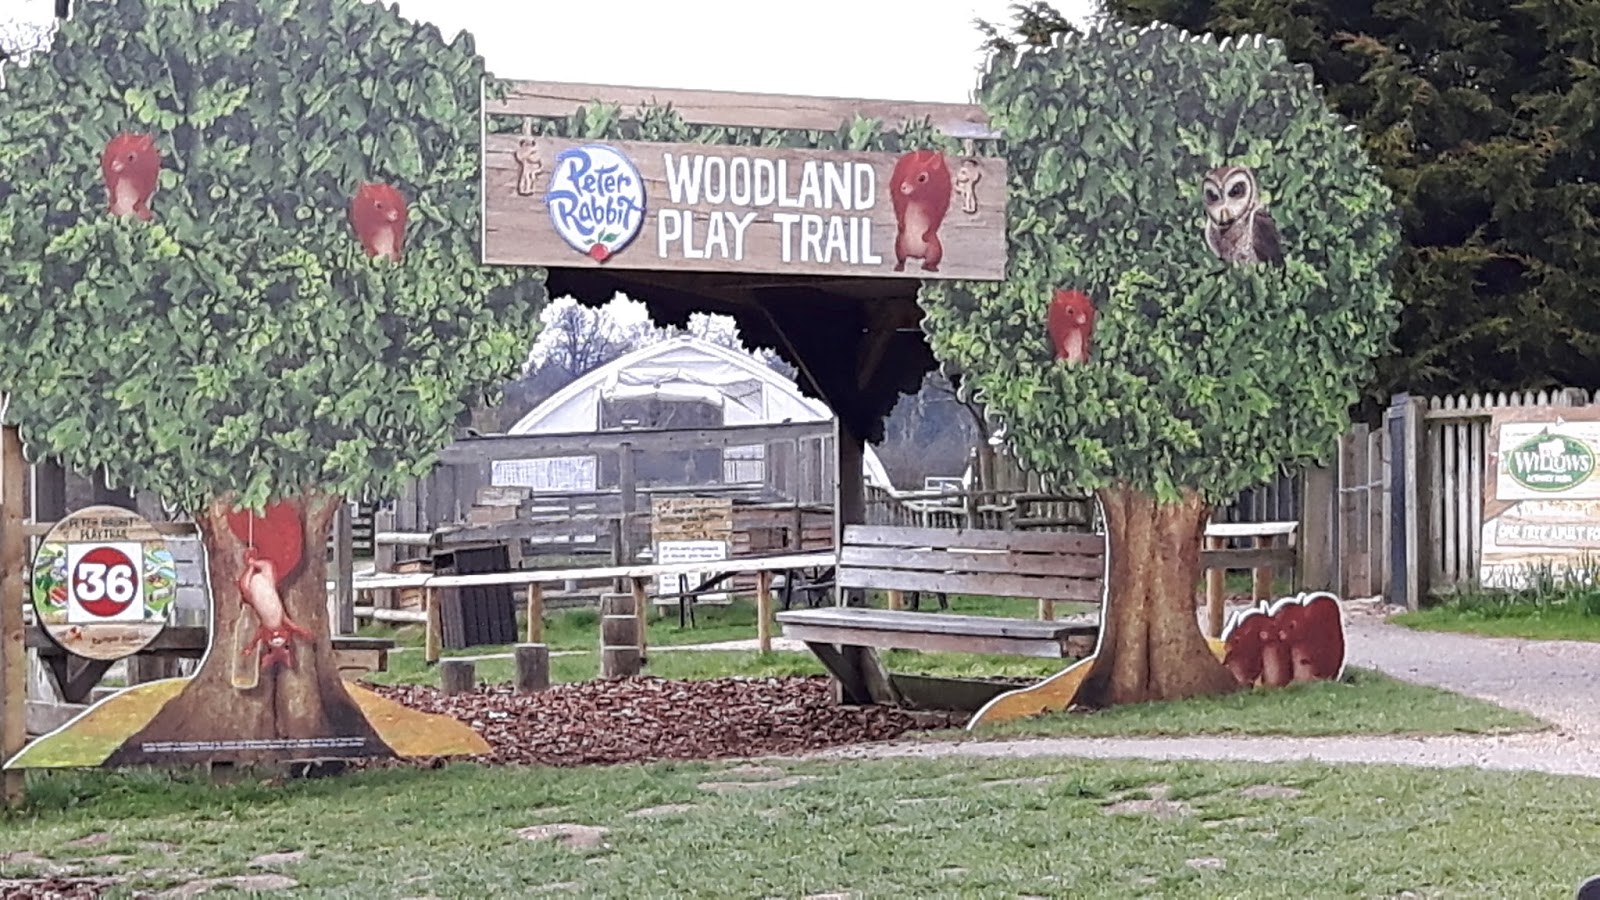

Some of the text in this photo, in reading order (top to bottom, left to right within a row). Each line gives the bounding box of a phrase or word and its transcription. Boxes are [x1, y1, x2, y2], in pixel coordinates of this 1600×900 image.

[556, 149, 631, 197] Peter
[664, 153, 876, 211] WOODLAND
[543, 190, 646, 235] Rabbit
[658, 209, 882, 265] PLAY TRAIL
[76, 563, 134, 603] 36
